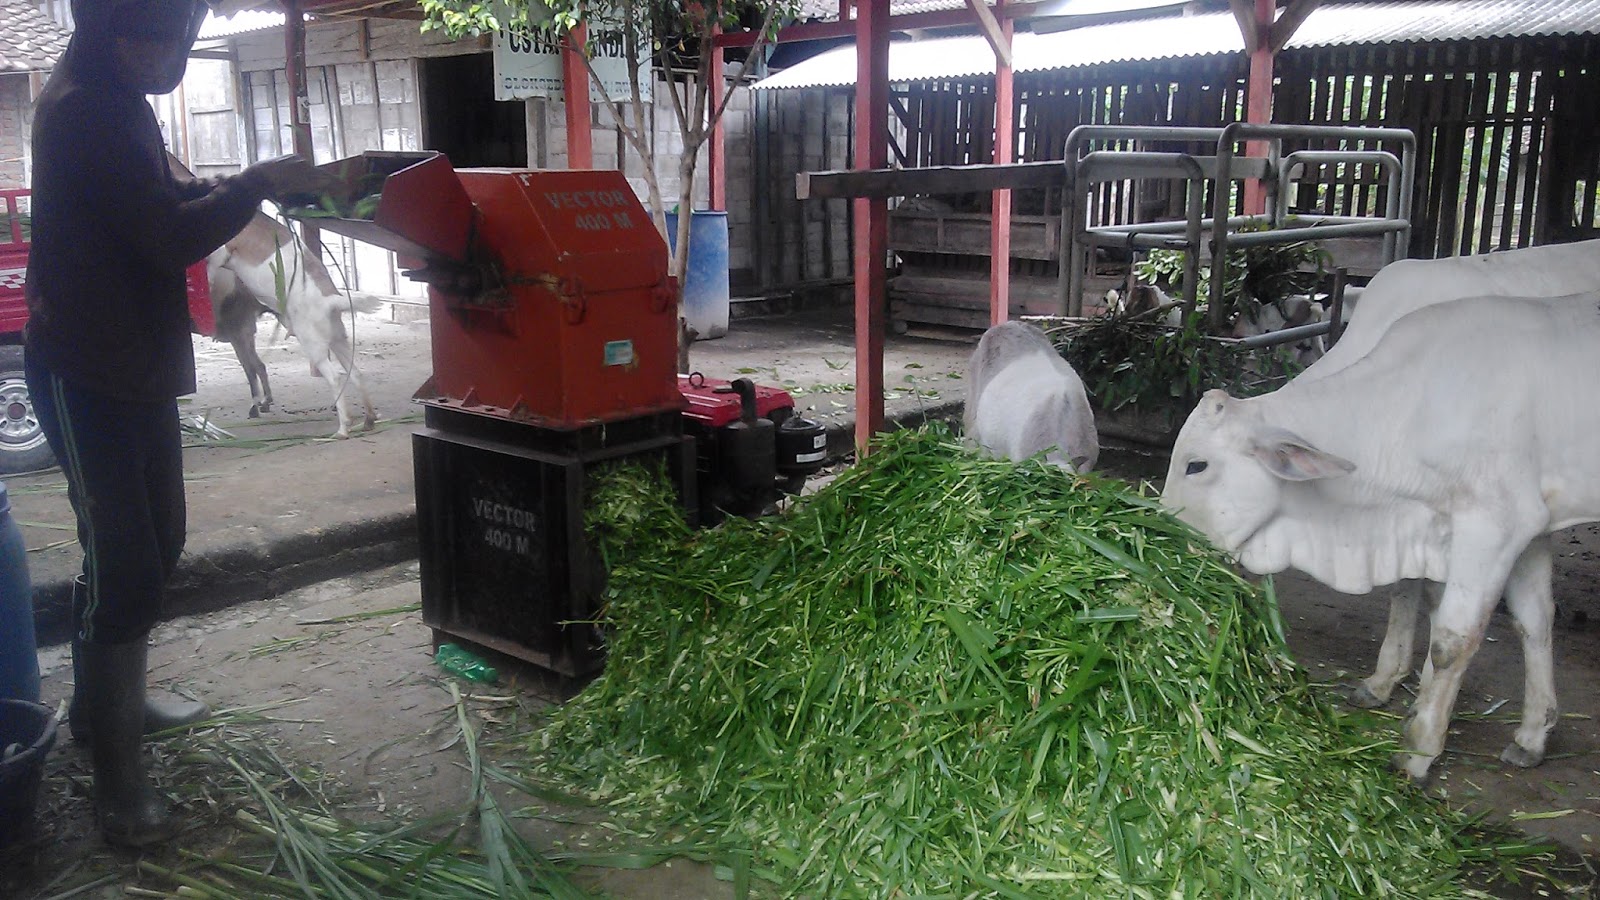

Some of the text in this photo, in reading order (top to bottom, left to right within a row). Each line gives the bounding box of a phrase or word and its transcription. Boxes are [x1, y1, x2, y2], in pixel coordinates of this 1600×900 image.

[545, 189, 630, 209] VECTOR
[575, 211, 634, 231] 400 M
[472, 497, 537, 533] VECTOR
[484, 528, 529, 555] 400 M
